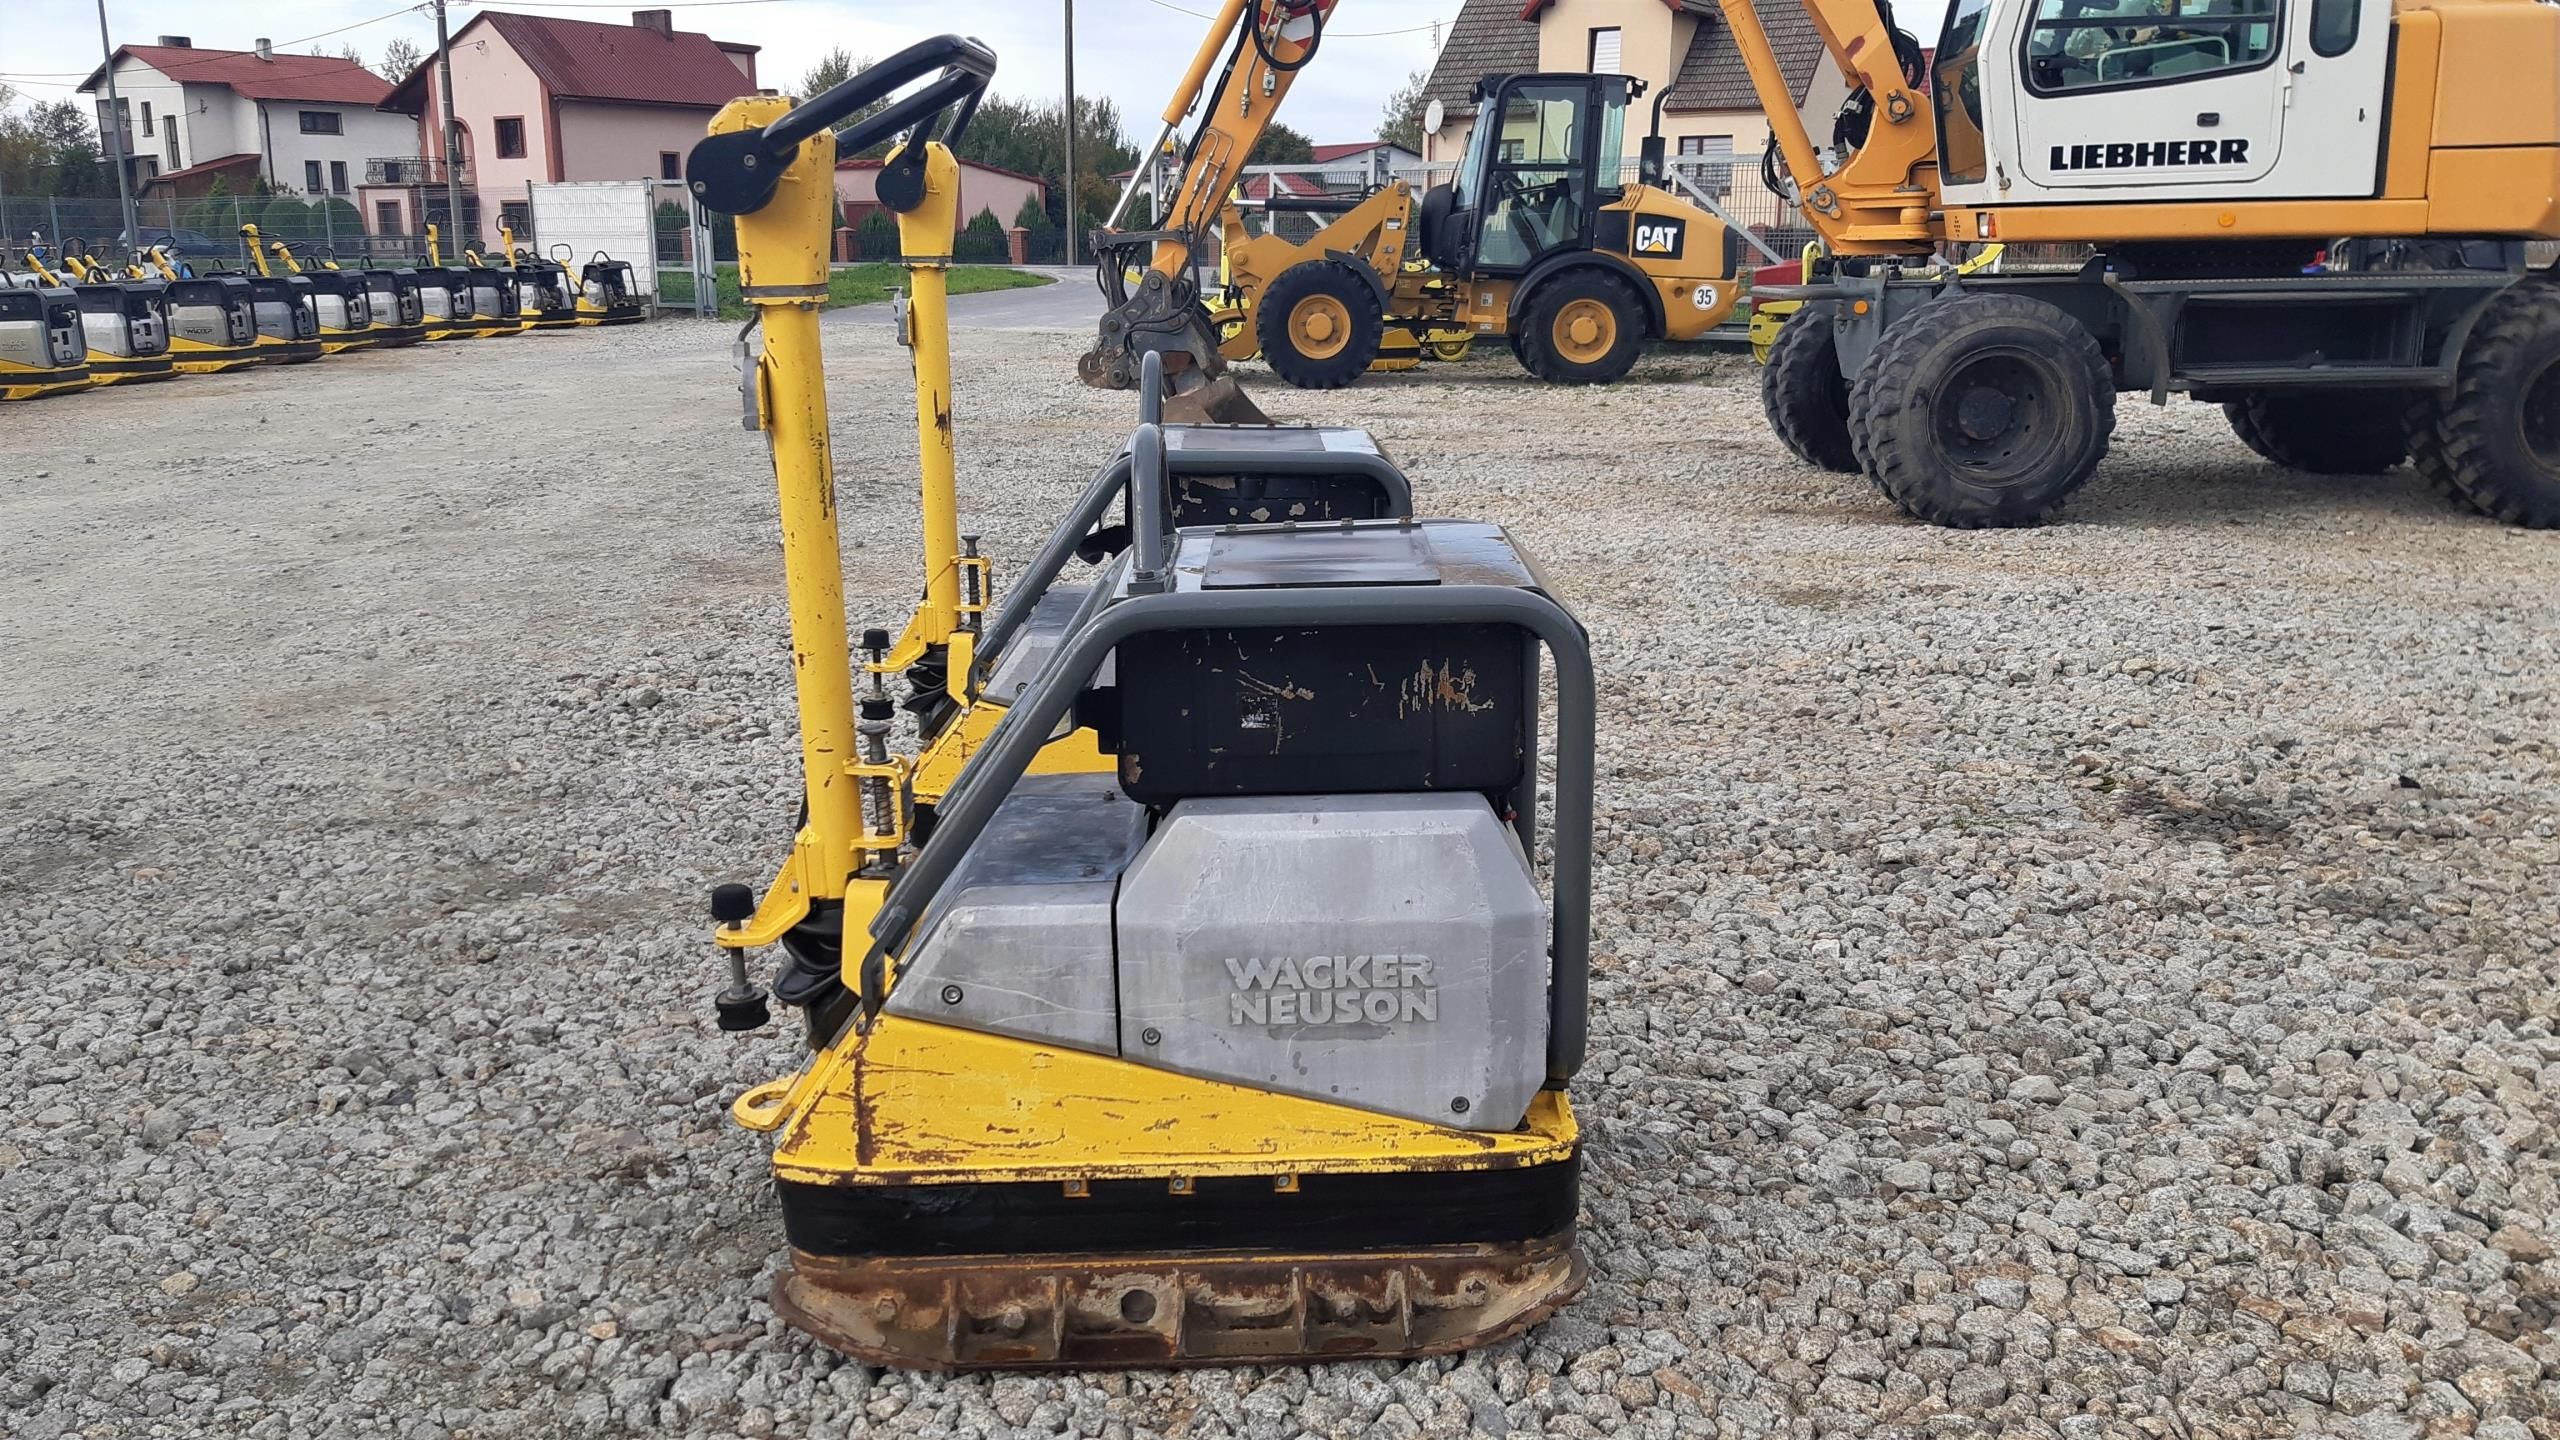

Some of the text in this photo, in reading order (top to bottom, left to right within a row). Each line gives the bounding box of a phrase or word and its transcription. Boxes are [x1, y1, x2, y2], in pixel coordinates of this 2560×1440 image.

[2050, 139, 2249, 171] LIEBHERR
[1636, 225, 1677, 253] CAT
[1696, 288, 1712, 306] 35
[1224, 954, 1437, 991] WACKER
[1230, 989, 1438, 1026] NEUSON
